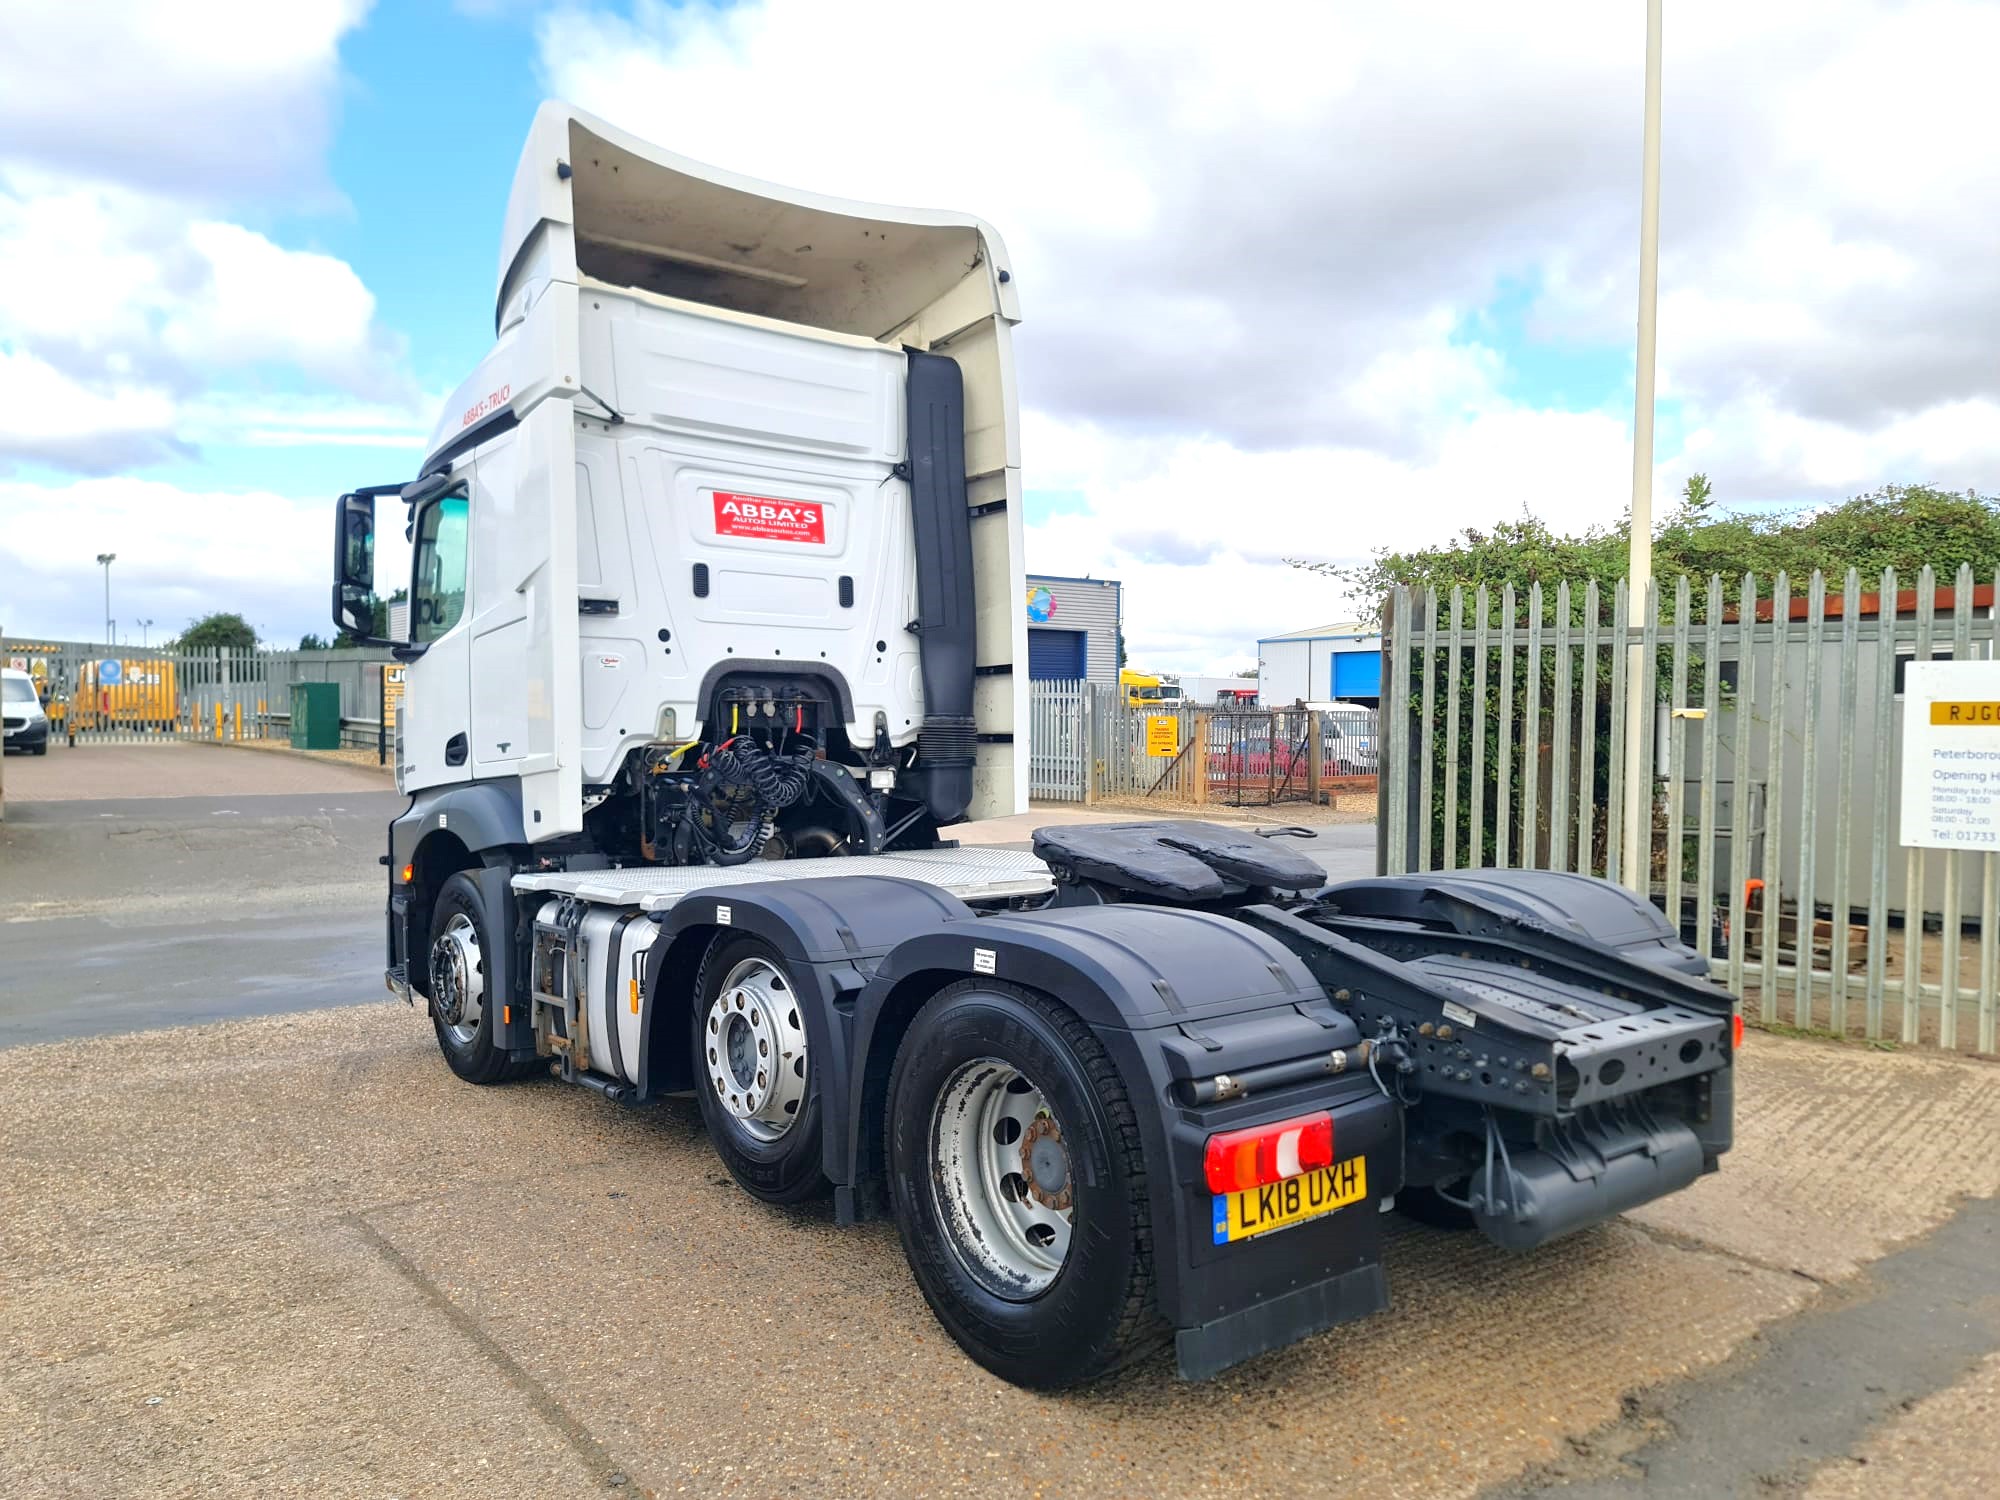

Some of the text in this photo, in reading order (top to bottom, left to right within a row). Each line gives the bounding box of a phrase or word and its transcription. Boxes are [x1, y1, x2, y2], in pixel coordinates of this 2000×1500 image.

[721, 501, 817, 523] ABBA'S
[732, 516, 808, 529] AUTOS LIMITED
[731, 524, 811, 536] www.abbasautos.com
[1932, 769, 1987, 783] Opening
[1932, 786, 1970, 796] Monday
[1931, 806, 1974, 817] Saturday
[1956, 830, 1996, 842] 01733
[1240, 1159, 1357, 1230] LK18 UXH
